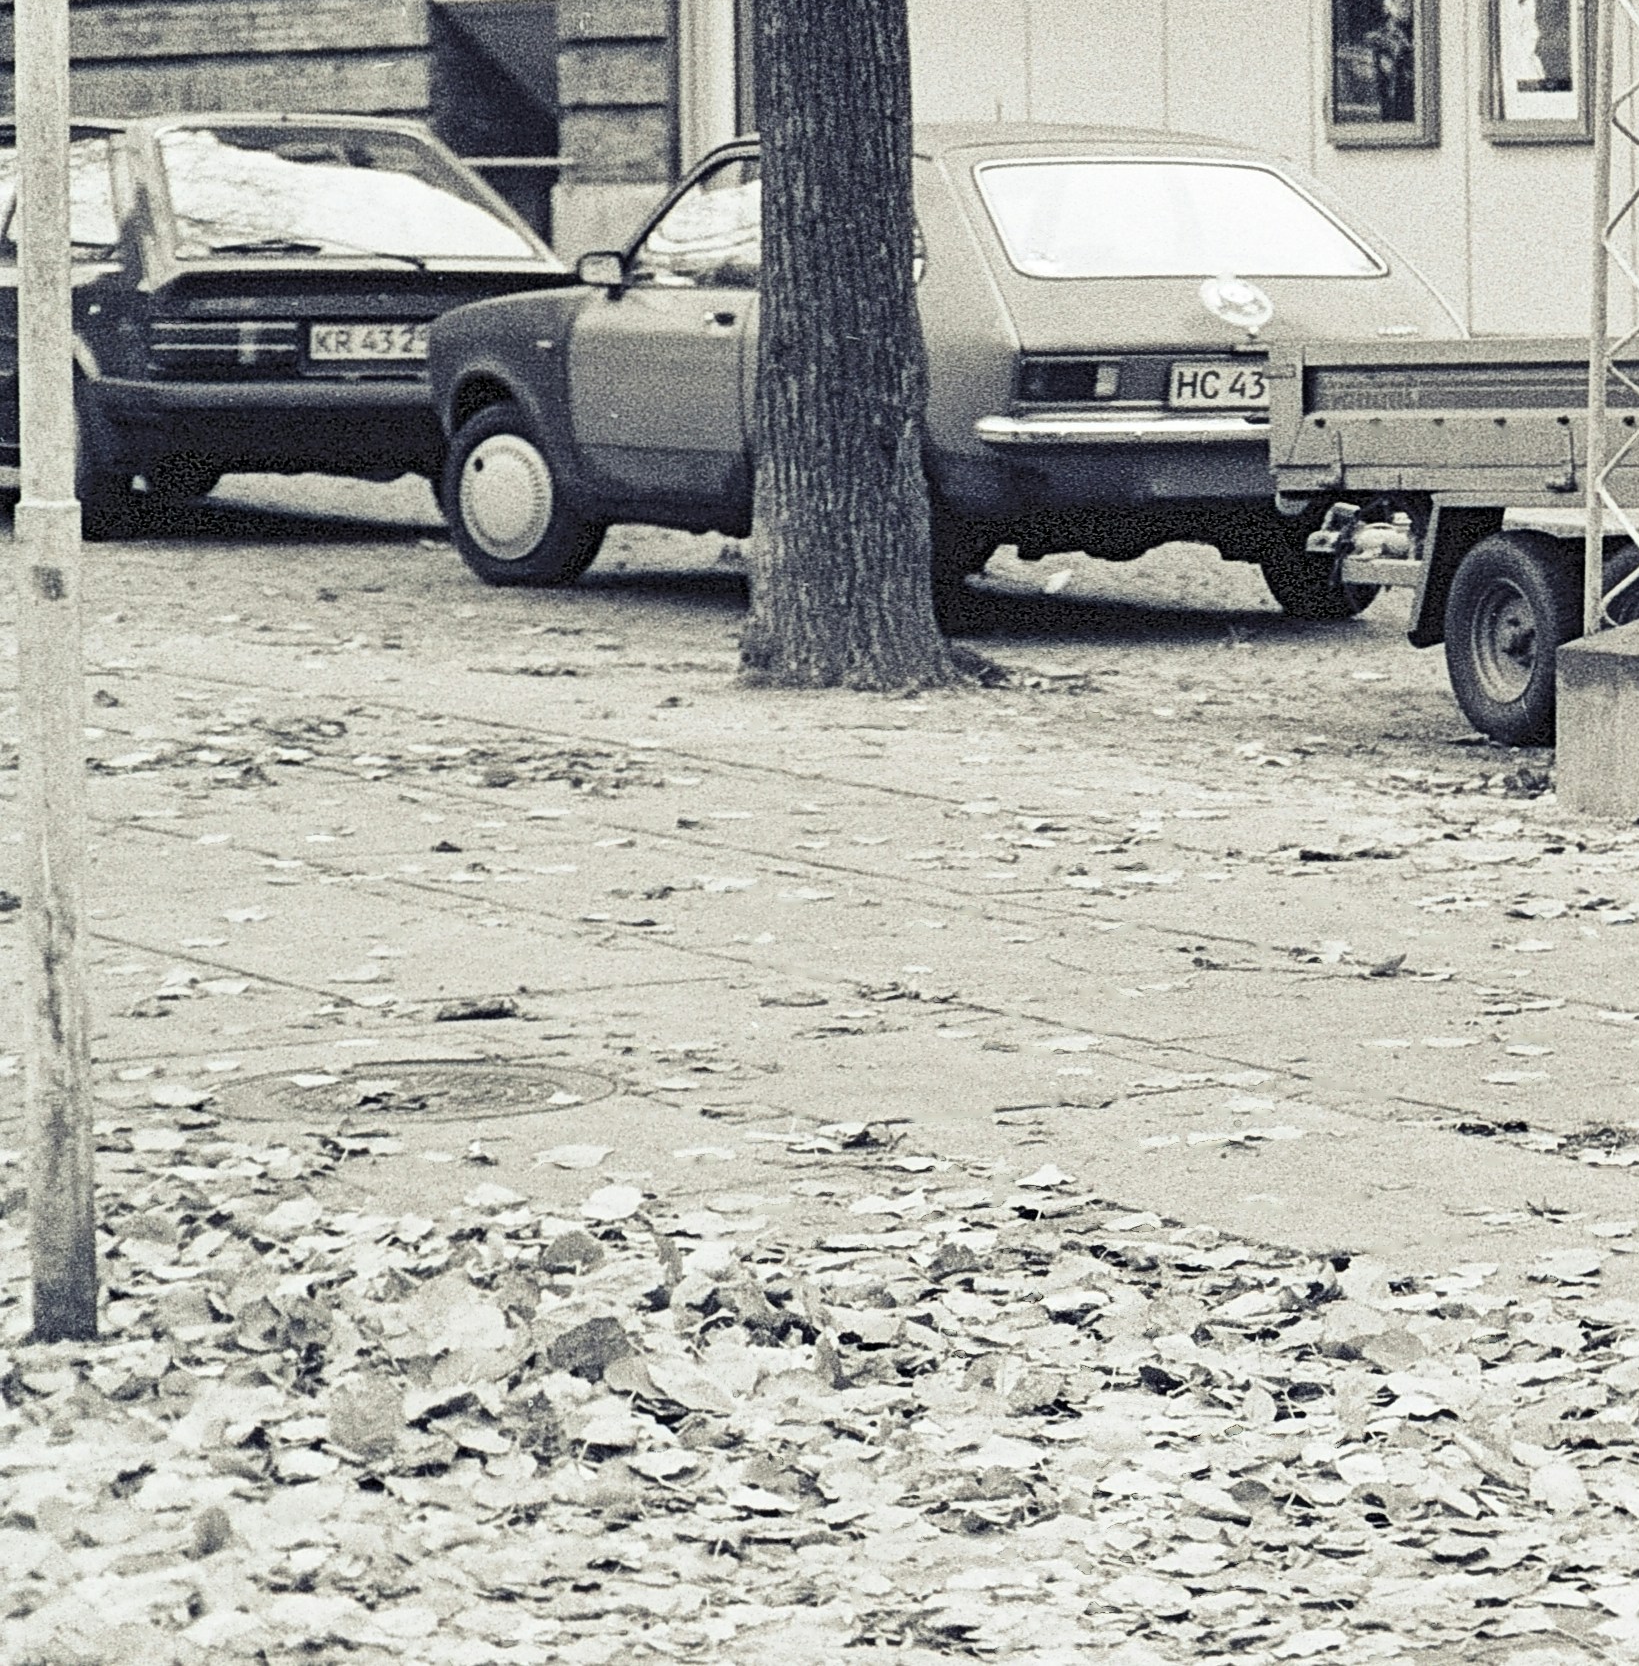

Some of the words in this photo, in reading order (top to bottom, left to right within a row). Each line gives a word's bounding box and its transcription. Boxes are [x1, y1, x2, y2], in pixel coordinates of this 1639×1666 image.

[315, 329, 353, 354] KR
[360, 328, 395, 354] 43
[1176, 369, 1221, 400] HC
[1228, 370, 1267, 400] 43
